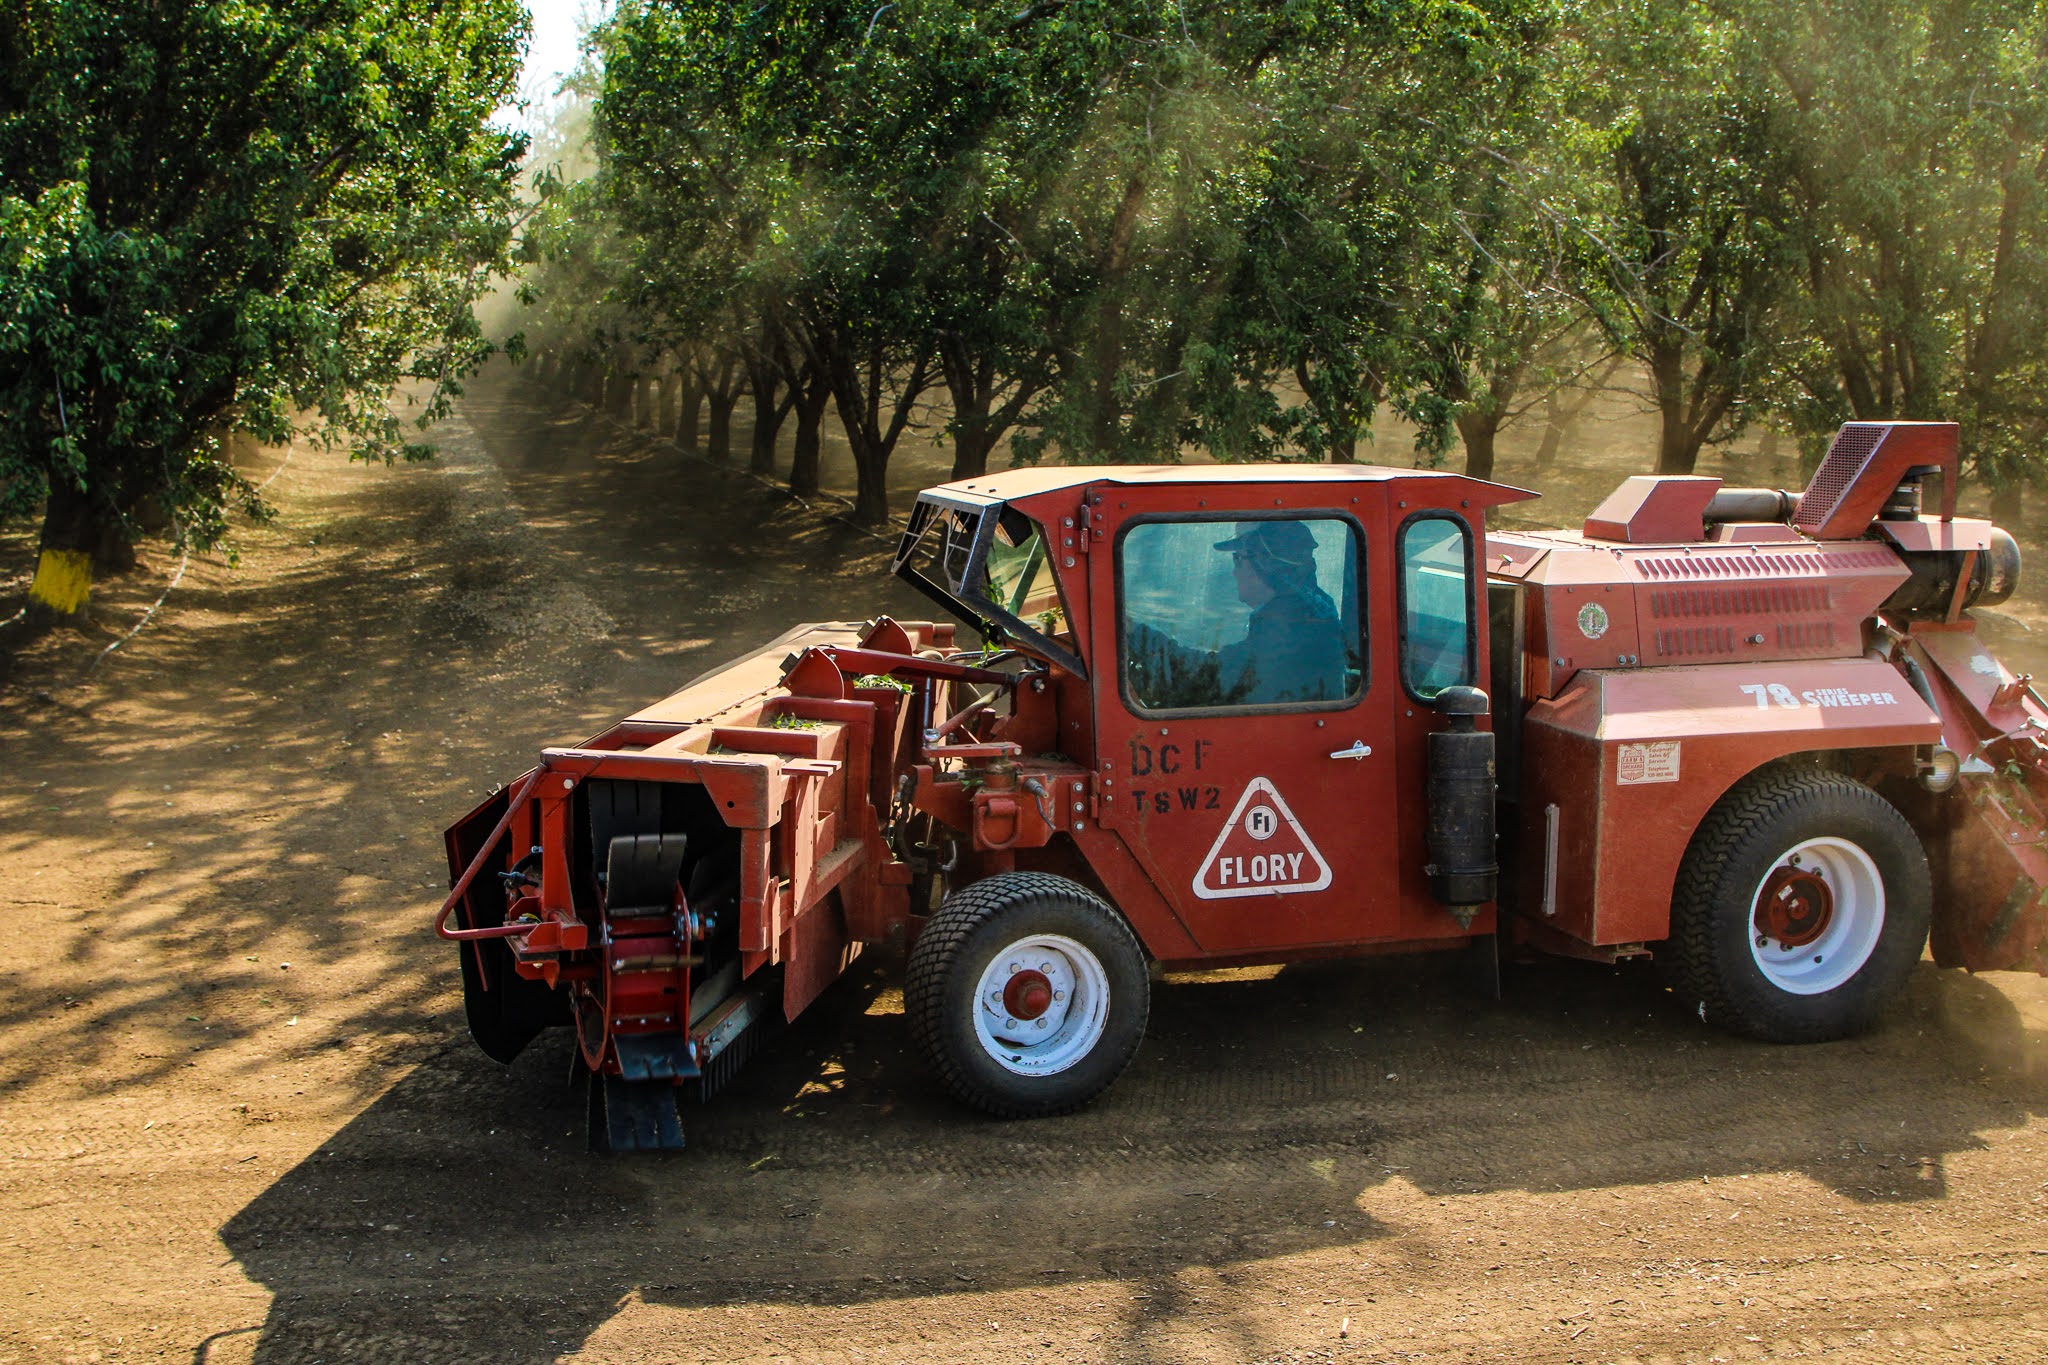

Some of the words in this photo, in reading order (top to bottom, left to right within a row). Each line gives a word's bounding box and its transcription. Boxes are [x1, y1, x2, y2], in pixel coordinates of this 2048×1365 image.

[1739, 683, 1801, 711] 78
[1802, 691, 1898, 708] SWEEPER
[1219, 852, 1304, 885] FLORY
